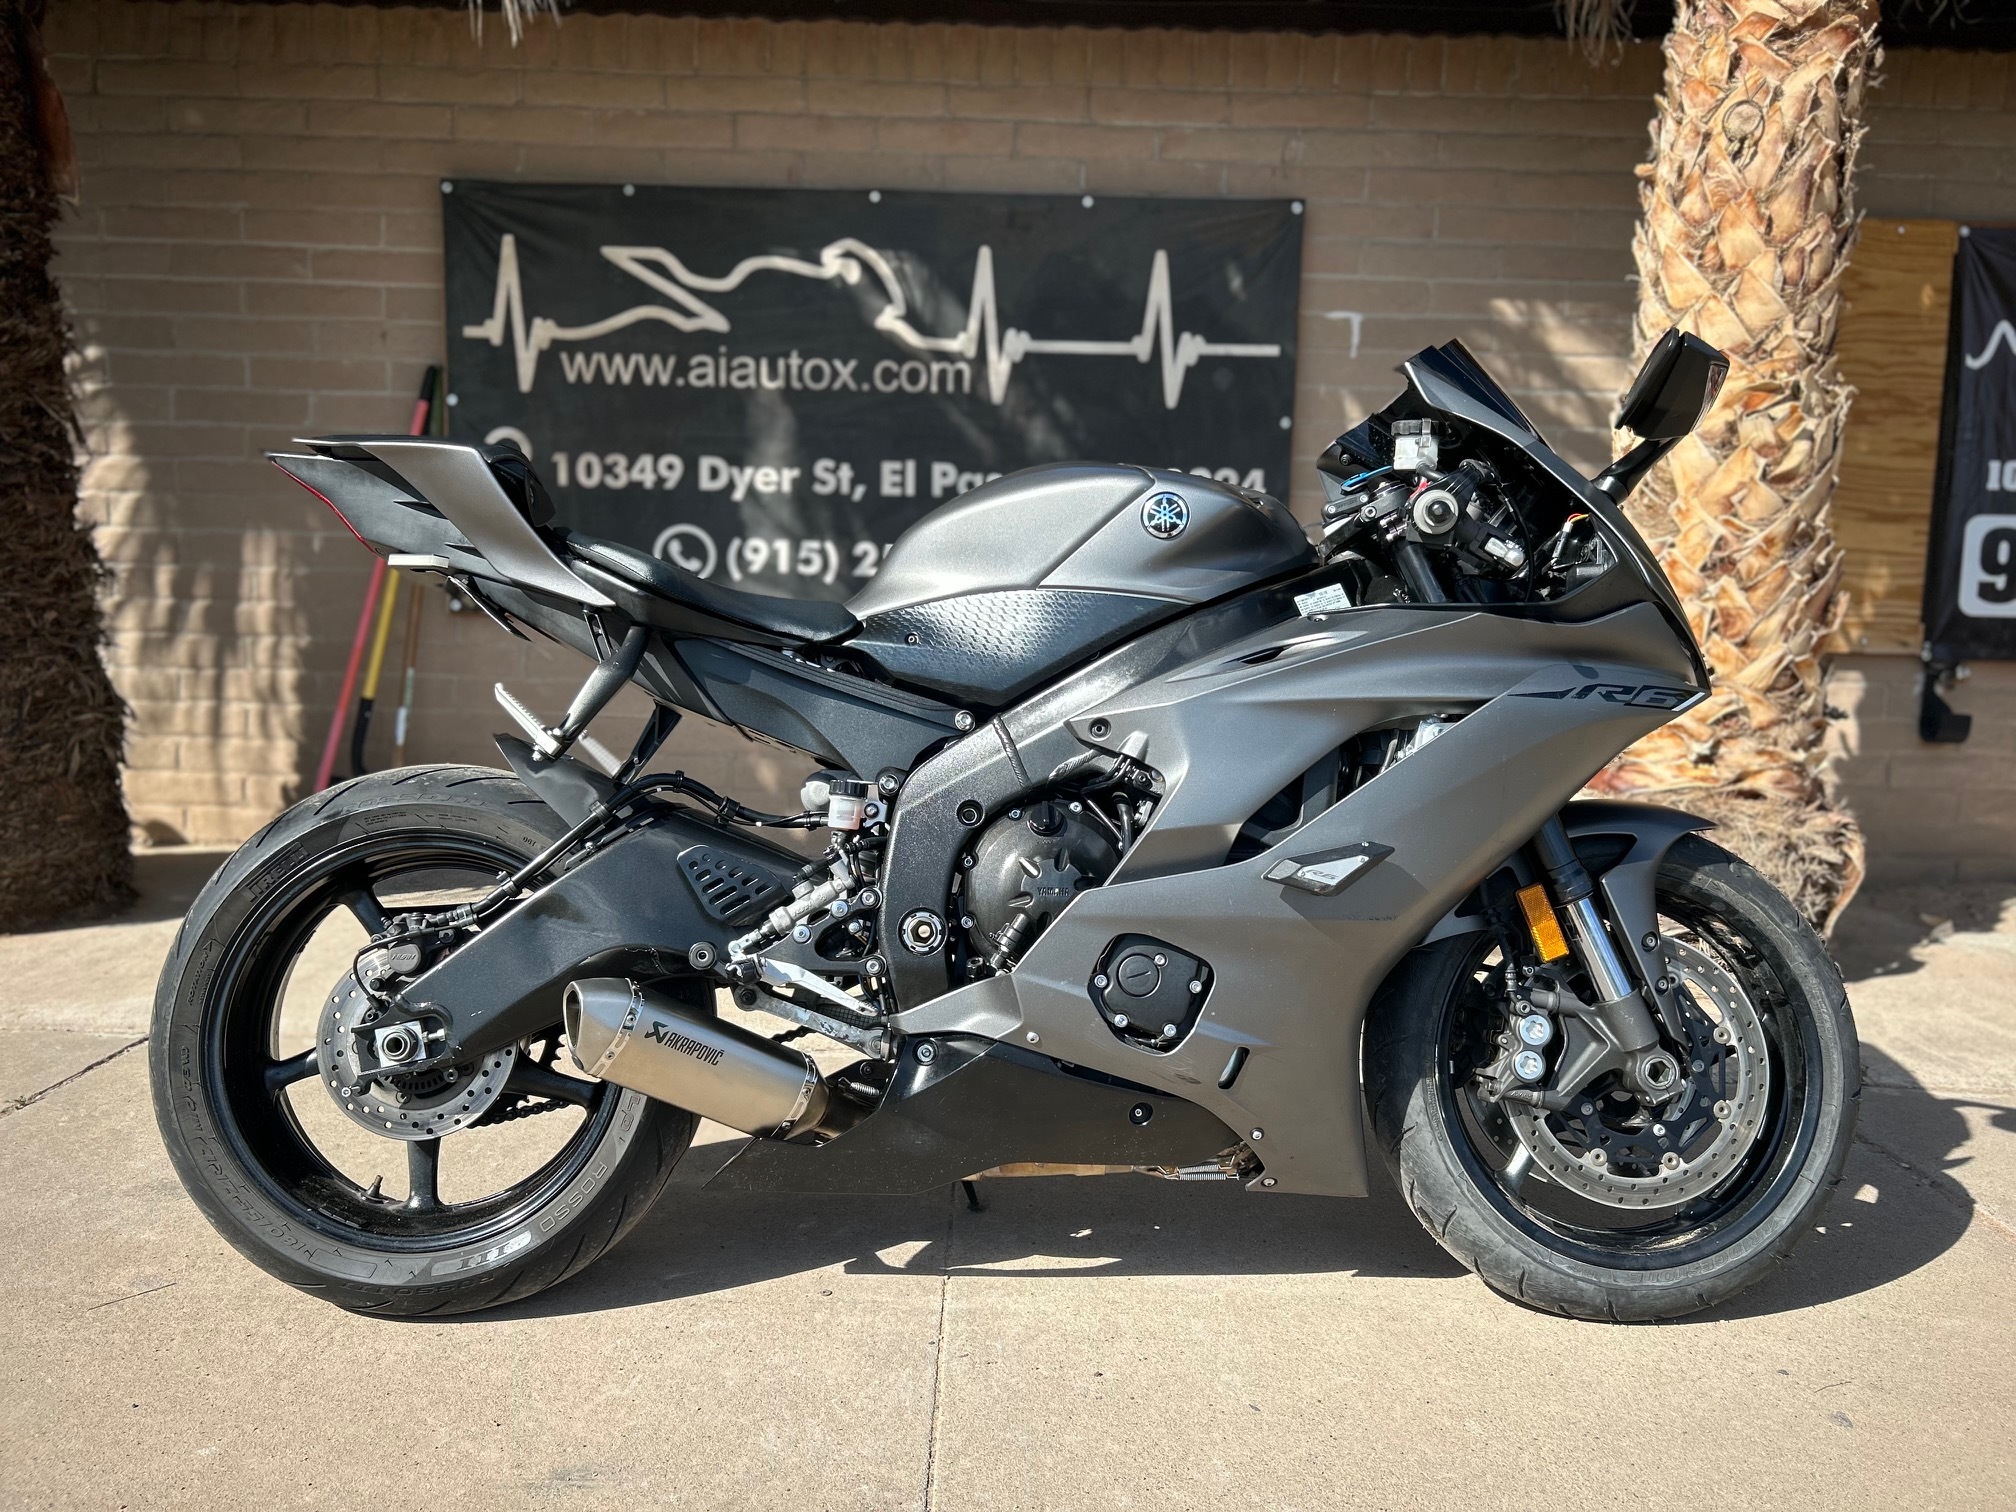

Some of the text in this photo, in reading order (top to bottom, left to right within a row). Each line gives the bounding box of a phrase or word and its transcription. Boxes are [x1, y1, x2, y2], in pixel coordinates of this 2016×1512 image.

[559, 346, 972, 394] www.aiautox.com
[551, 452, 685, 490] 10349
[698, 455, 801, 501] Dyer
[811, 457, 867, 500] St,
[879, 459, 917, 497] El
[726, 536, 839, 585] (915)
[1571, 683, 1700, 711] R6
[1037, 886, 1071, 896] YAMAHA
[1306, 869, 1338, 880] R6
[539, 1161, 608, 1233] ROSSO
